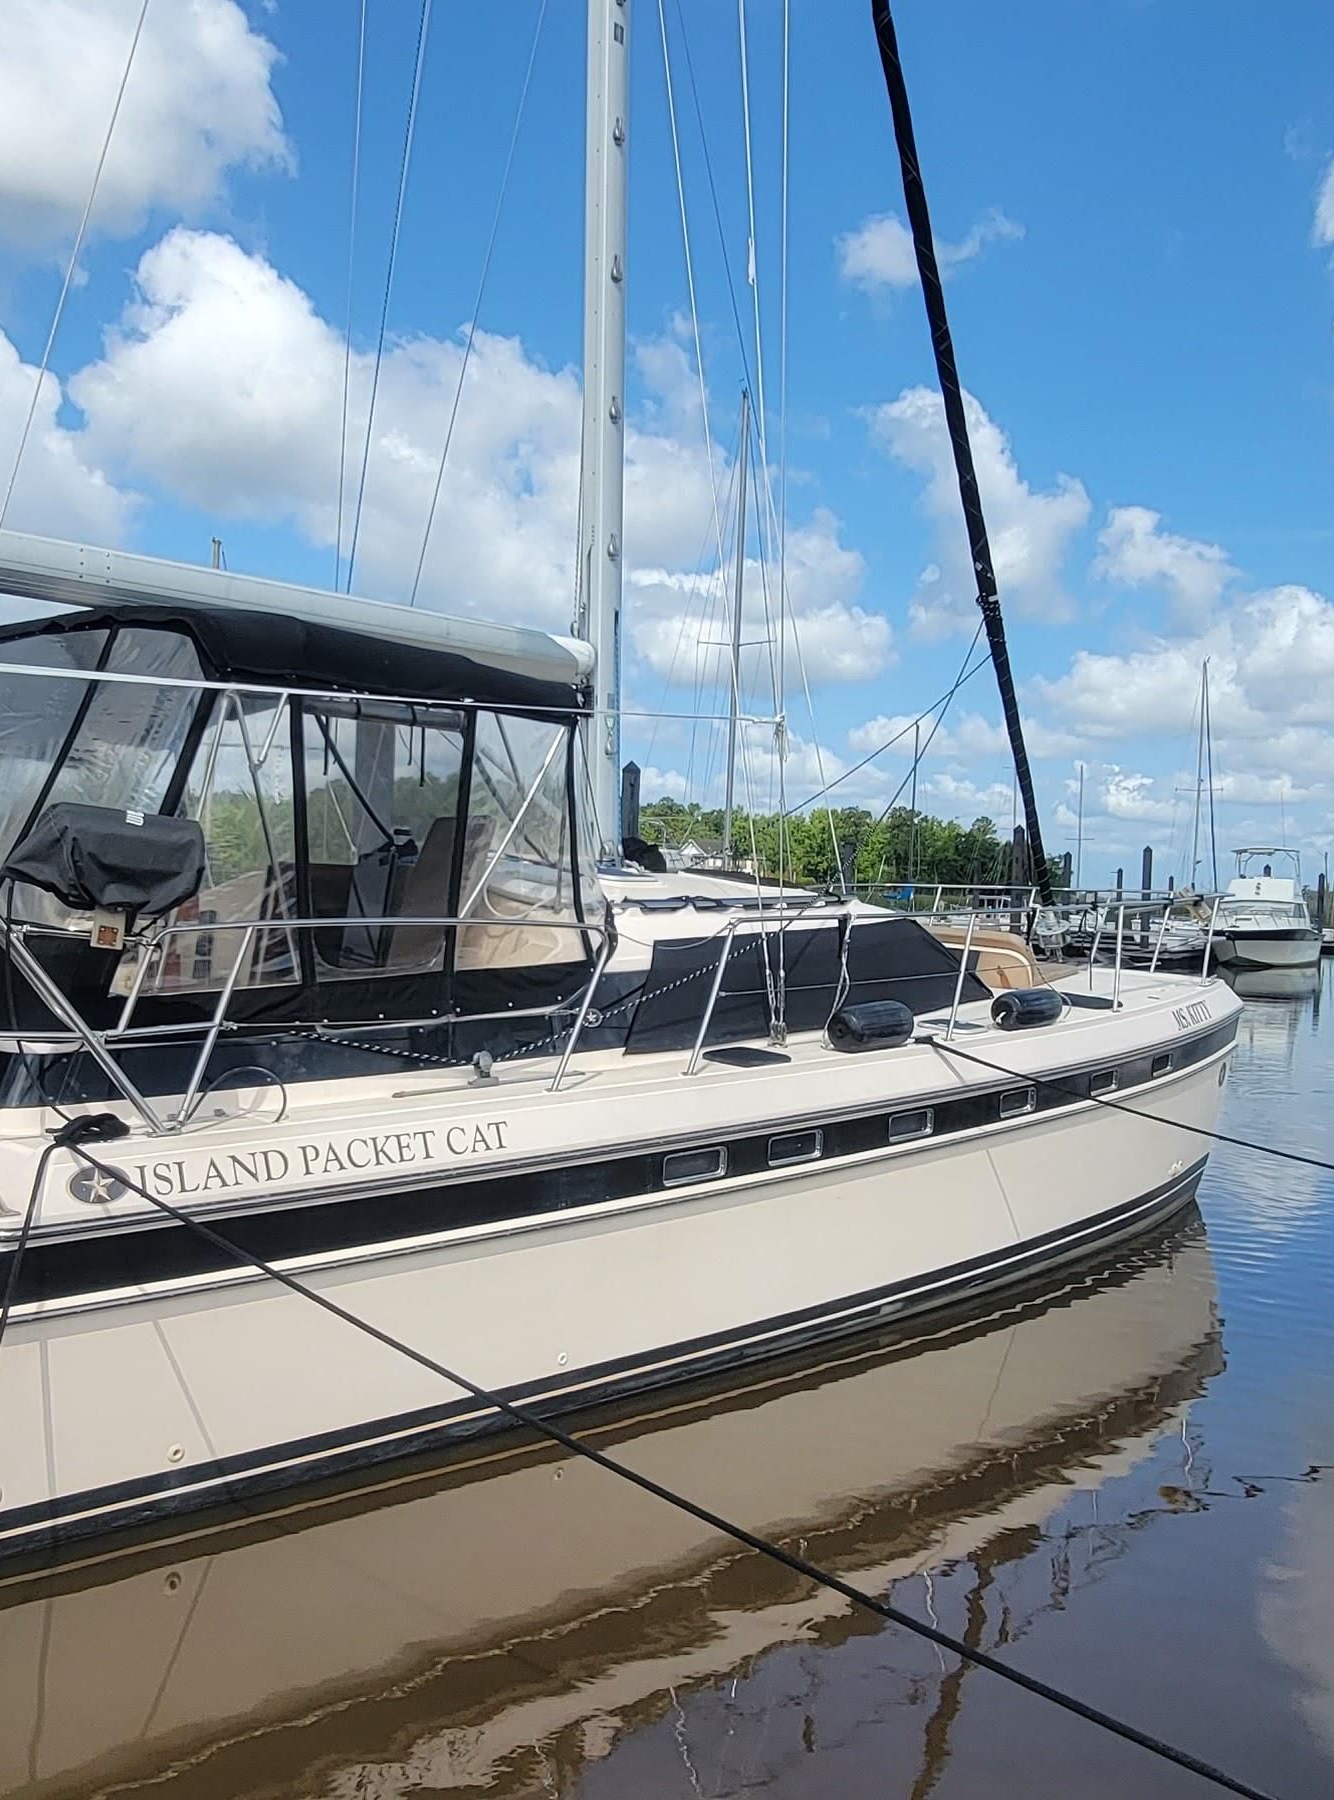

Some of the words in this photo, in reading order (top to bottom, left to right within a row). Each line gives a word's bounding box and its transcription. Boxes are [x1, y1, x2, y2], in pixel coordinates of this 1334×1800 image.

[1185, 999, 1213, 1027] KITTY
[134, 1148, 289, 1197] ISLAND
[299, 1130, 436, 1176] PACKET
[445, 1120, 509, 1156] CAT
